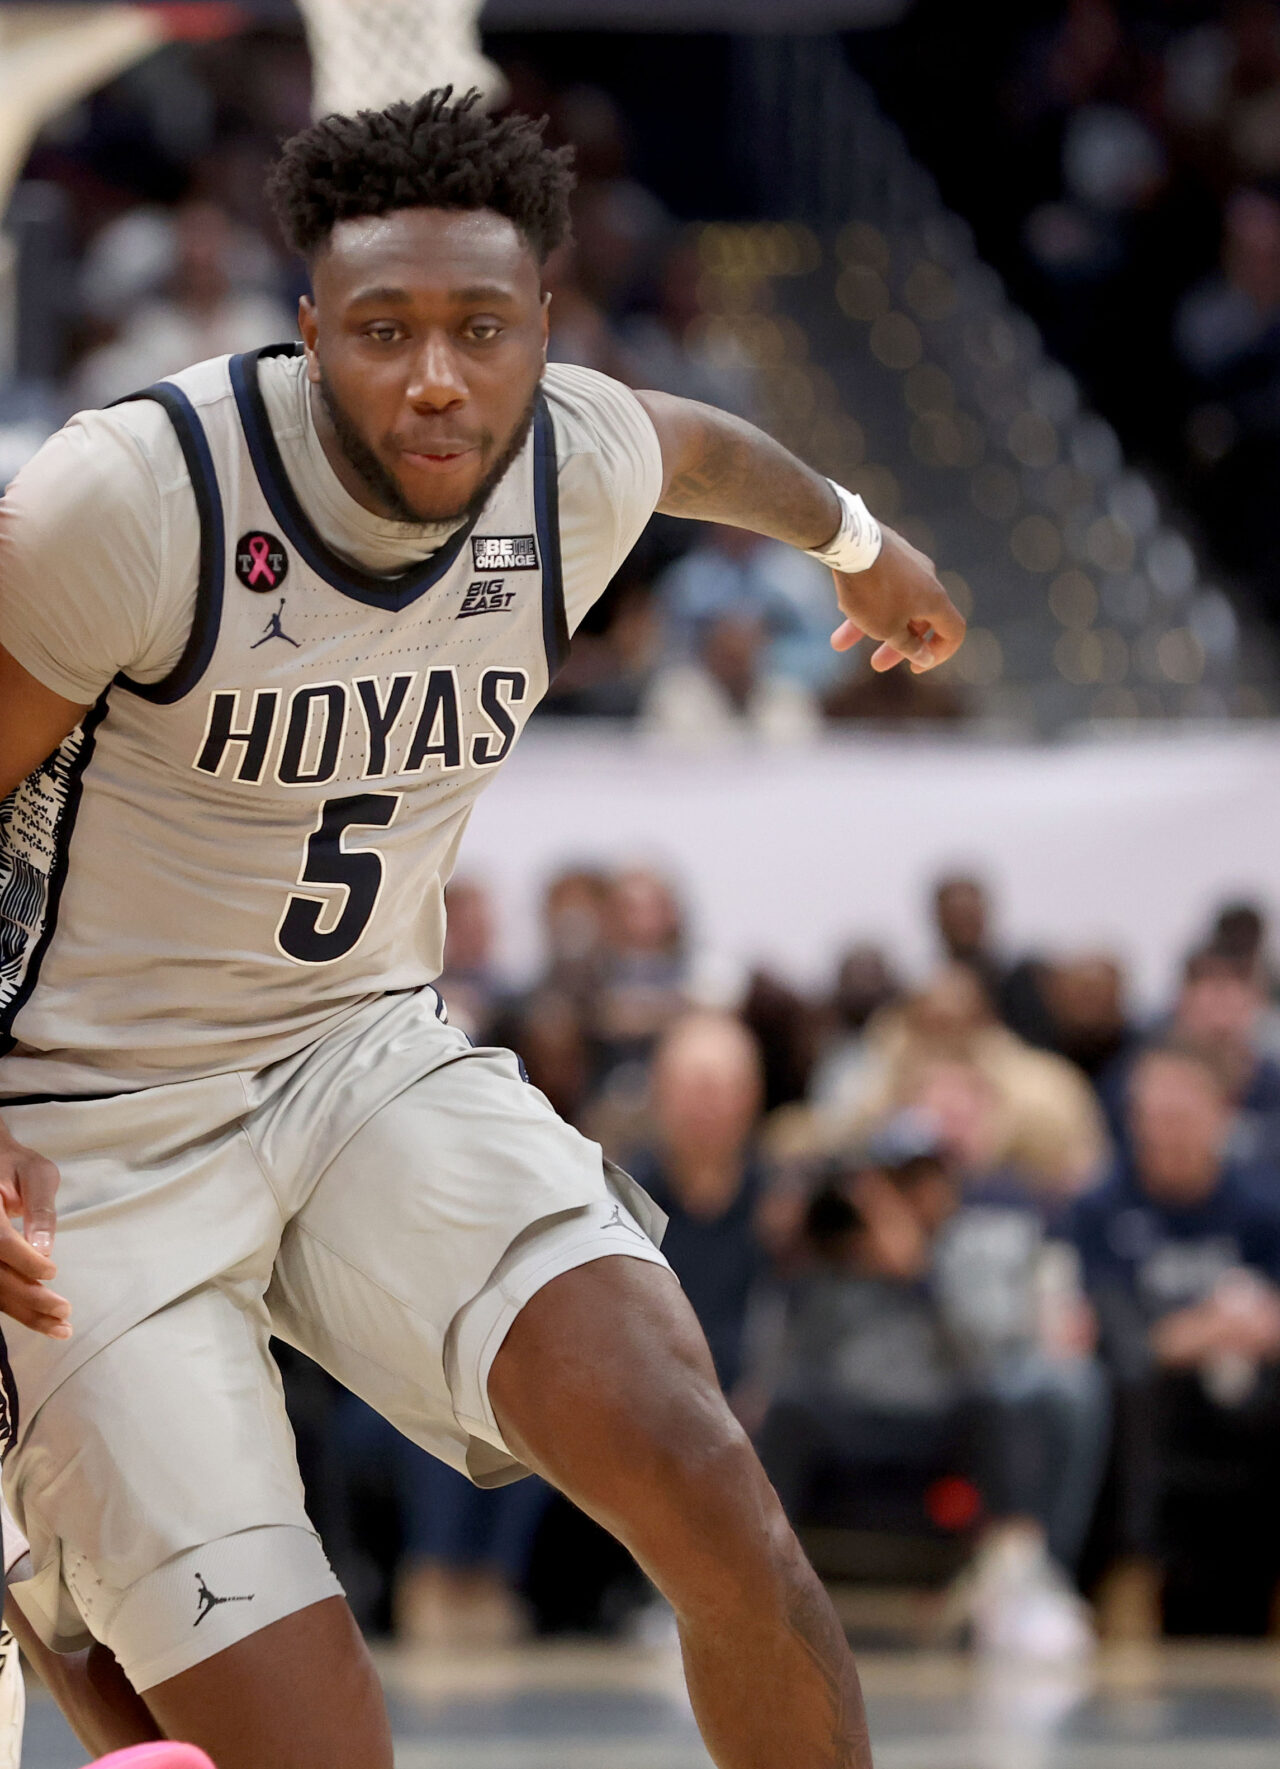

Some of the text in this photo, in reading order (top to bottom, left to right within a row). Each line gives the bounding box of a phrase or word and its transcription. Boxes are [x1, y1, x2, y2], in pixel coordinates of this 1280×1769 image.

[475, 554, 536, 569] CHANGE
[466, 578, 504, 597] BIG
[460, 592, 516, 611] EAST
[192, 665, 530, 788] HOYAS
[274, 791, 405, 967] 5
